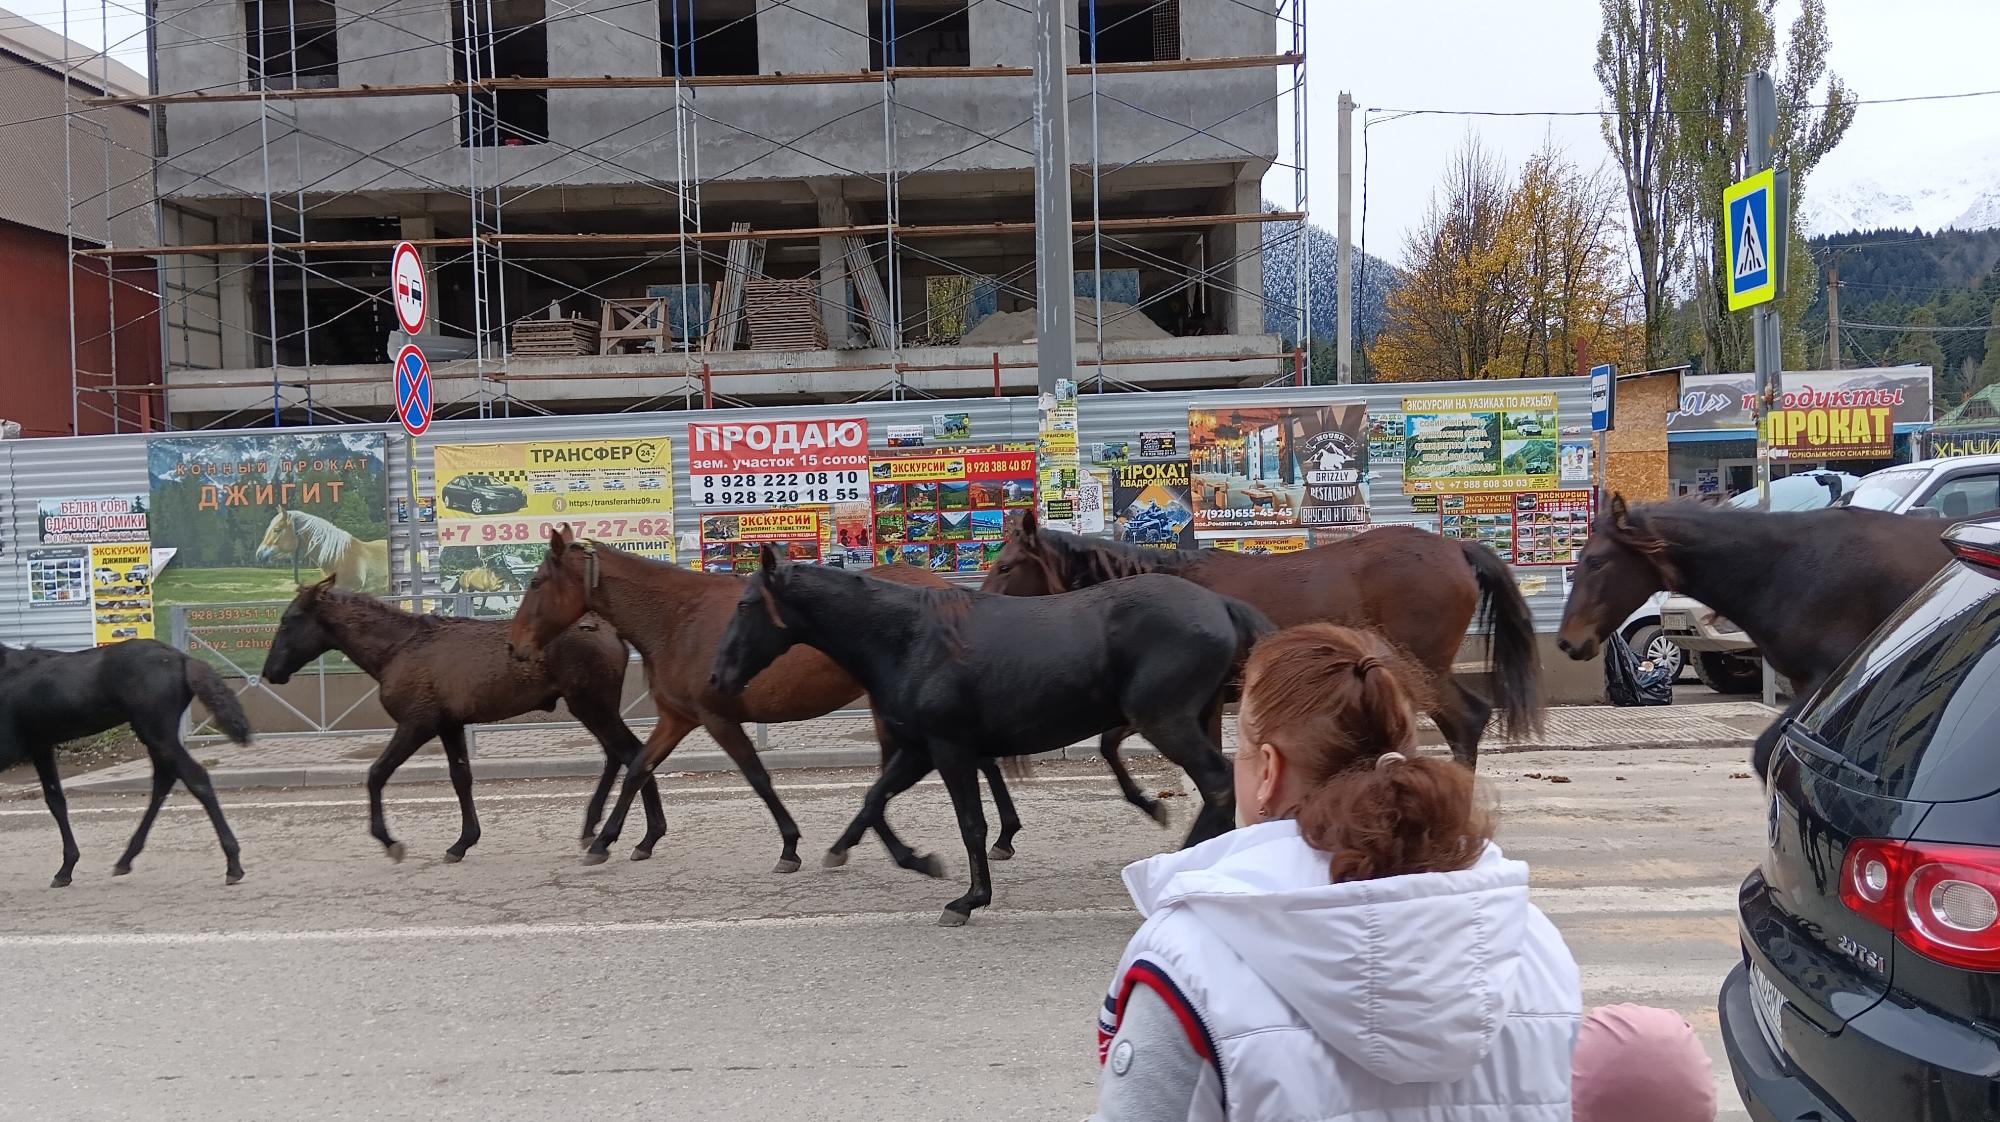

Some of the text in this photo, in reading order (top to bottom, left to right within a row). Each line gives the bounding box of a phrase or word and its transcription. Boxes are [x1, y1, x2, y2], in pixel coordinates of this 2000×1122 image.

[1407, 395, 1553, 411] ЭКСКУРСИИ НА УАЗИКАХ ПО АРХЫЗУ
[1742, 384, 1904, 411] подукты
[1767, 407, 1890, 448] ПРОКАТ
[695, 422, 863, 454] ПРОДАЮ
[530, 446, 633, 462] ТРАНСФЕР
[1789, 450, 1846, 458] ГОРНОЛЫЖНОГО
[176, 458, 368, 475] КОННЫЙ ПРОКАТ
[693, 455, 867, 470] зем. участок 15 соток
[892, 462, 945, 473] ЭКСКУРСИИ
[966, 459, 1032, 473] 8 928 388 40 87
[1120, 463, 1188, 479] ПРОКАТ
[1316, 472, 1349, 482] GRIZZLY
[704, 472, 858, 488] 8 928 222 08 10
[1120, 478, 1189, 488] КВАДРОЦИКЛОВ
[1450, 481, 1460, 489] +7
[1483, 480, 1499, 488] 608
[1517, 479, 1527, 487] 03
[198, 481, 344, 511] ДЖИГИТ
[704, 488, 858, 504] 8 928 220 18 55
[1310, 486, 1357, 502] RESTAURANT
[61, 500, 128, 514] БЕЛАЯ СОВА
[1194, 508, 1293, 520] +7(928)655-45-45
[1341, 507, 1364, 521] ГОРЫ
[45, 515, 145, 531] СДАЮТСЯ ДОМИКИ
[741, 515, 811, 526] ЭКСКУРСИИ
[441, 518, 670, 543] +7 938 07-27-62
[93, 546, 148, 556] ЭКСКУРСИИ
